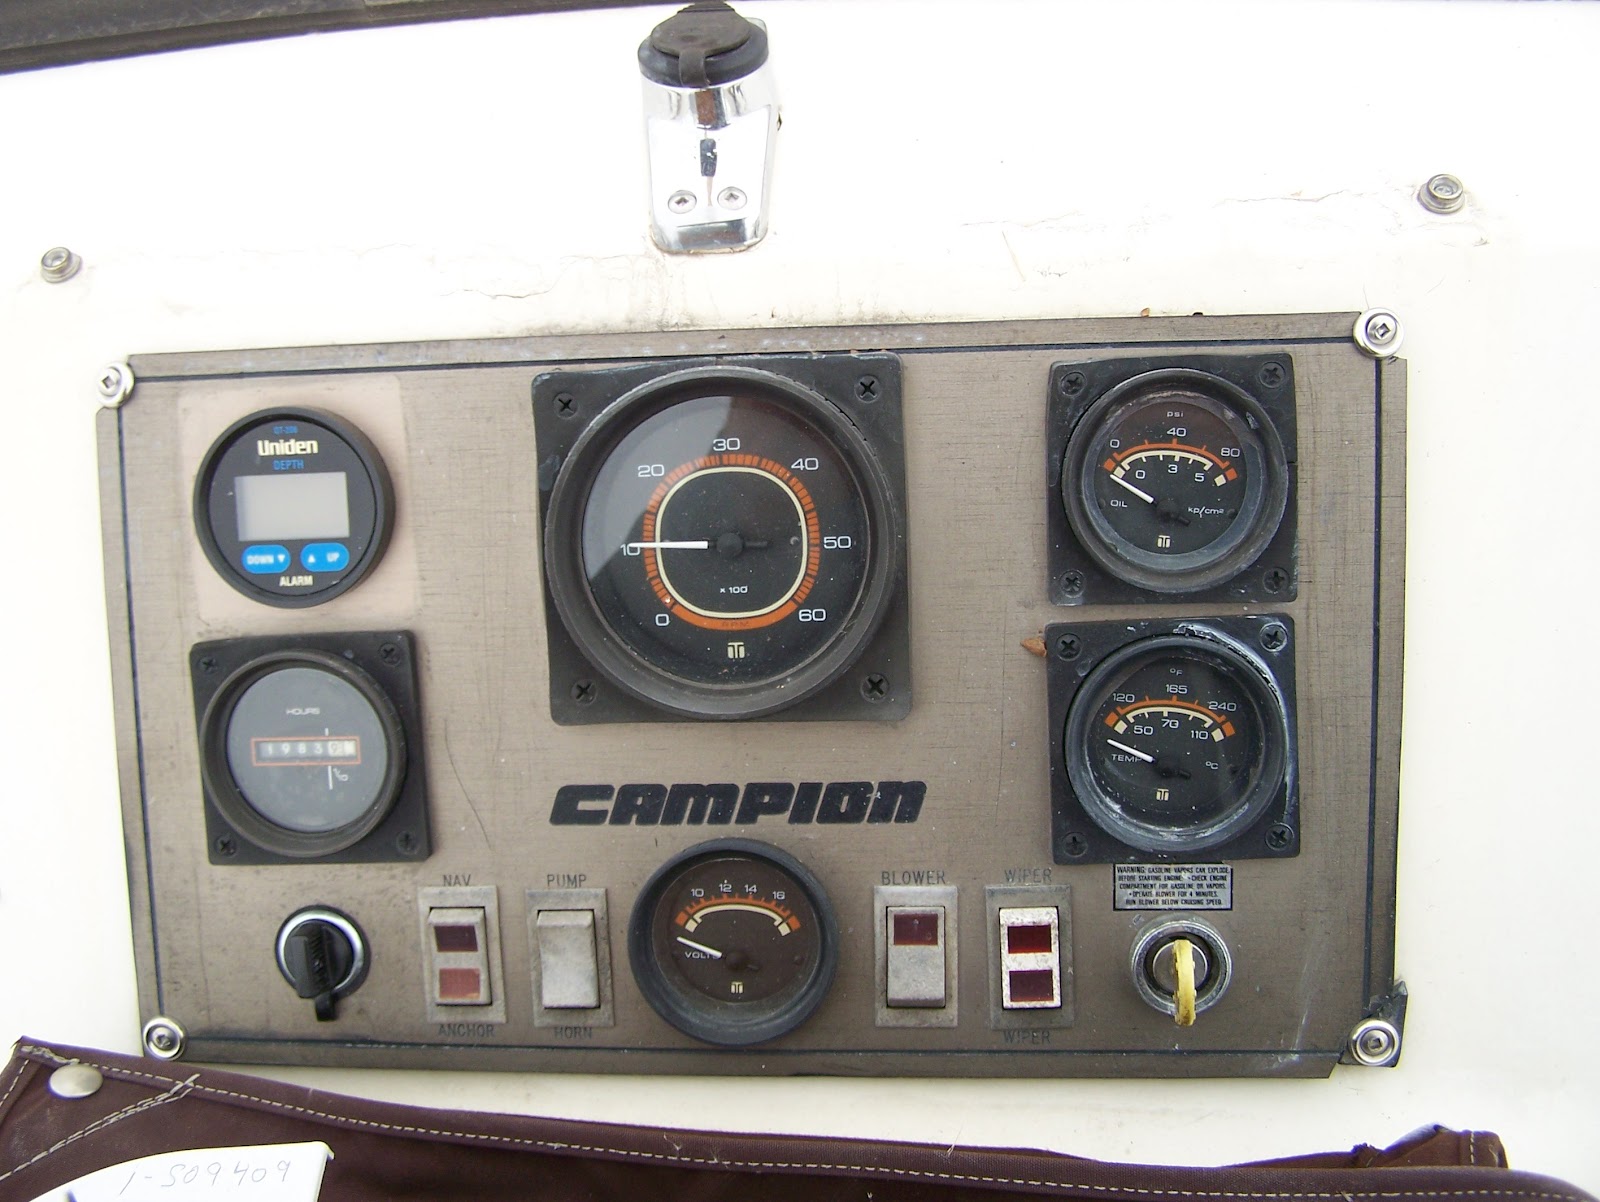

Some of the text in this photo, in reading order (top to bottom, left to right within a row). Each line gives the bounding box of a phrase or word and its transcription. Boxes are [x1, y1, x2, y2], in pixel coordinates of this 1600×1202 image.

[1166, 427, 1187, 437] 40
[257, 438, 319, 456] Uniden
[712, 437, 741, 452] 30
[1109, 438, 1121, 449] 0
[1220, 447, 1241, 458] 80
[273, 459, 304, 470] DEPTH
[790, 457, 820, 472] 40
[1167, 464, 1179, 474] 3
[637, 464, 666, 478] 20
[1135, 469, 1146, 480] 0
[1194, 472, 1205, 483] 5
[1110, 499, 1128, 508] OIL
[823, 535, 852, 549] 50
[619, 543, 642, 557] 10
[246, 554, 274, 565] DOWN
[326, 552, 341, 563] UP
[279, 575, 314, 587] ALARM
[728, 585, 748, 594] 100
[655, 613, 671, 627] 0
[798, 608, 827, 622] 60
[1165, 683, 1188, 694] 165
[1112, 692, 1136, 703] 120
[285, 706, 321, 716] HOURS
[1208, 700, 1237, 712] 240
[1161, 718, 1179, 729] 70
[1133, 725, 1154, 736] 50
[1190, 730, 1209, 740] 110
[549, 781, 927, 825] CAMPION
[443, 874, 472, 887] NAV
[546, 874, 587, 888] PUMP
[881, 870, 946, 885] BLOWER
[1004, 868, 1053, 883] WIPER
[691, 888, 705, 898] 10
[718, 883, 732, 893] 12
[744, 884, 758, 893] 14
[437, 1023, 495, 1038] ANCHOR
[553, 1027, 593, 1039] HORN
[1003, 1030, 1051, 1044] WIPER
